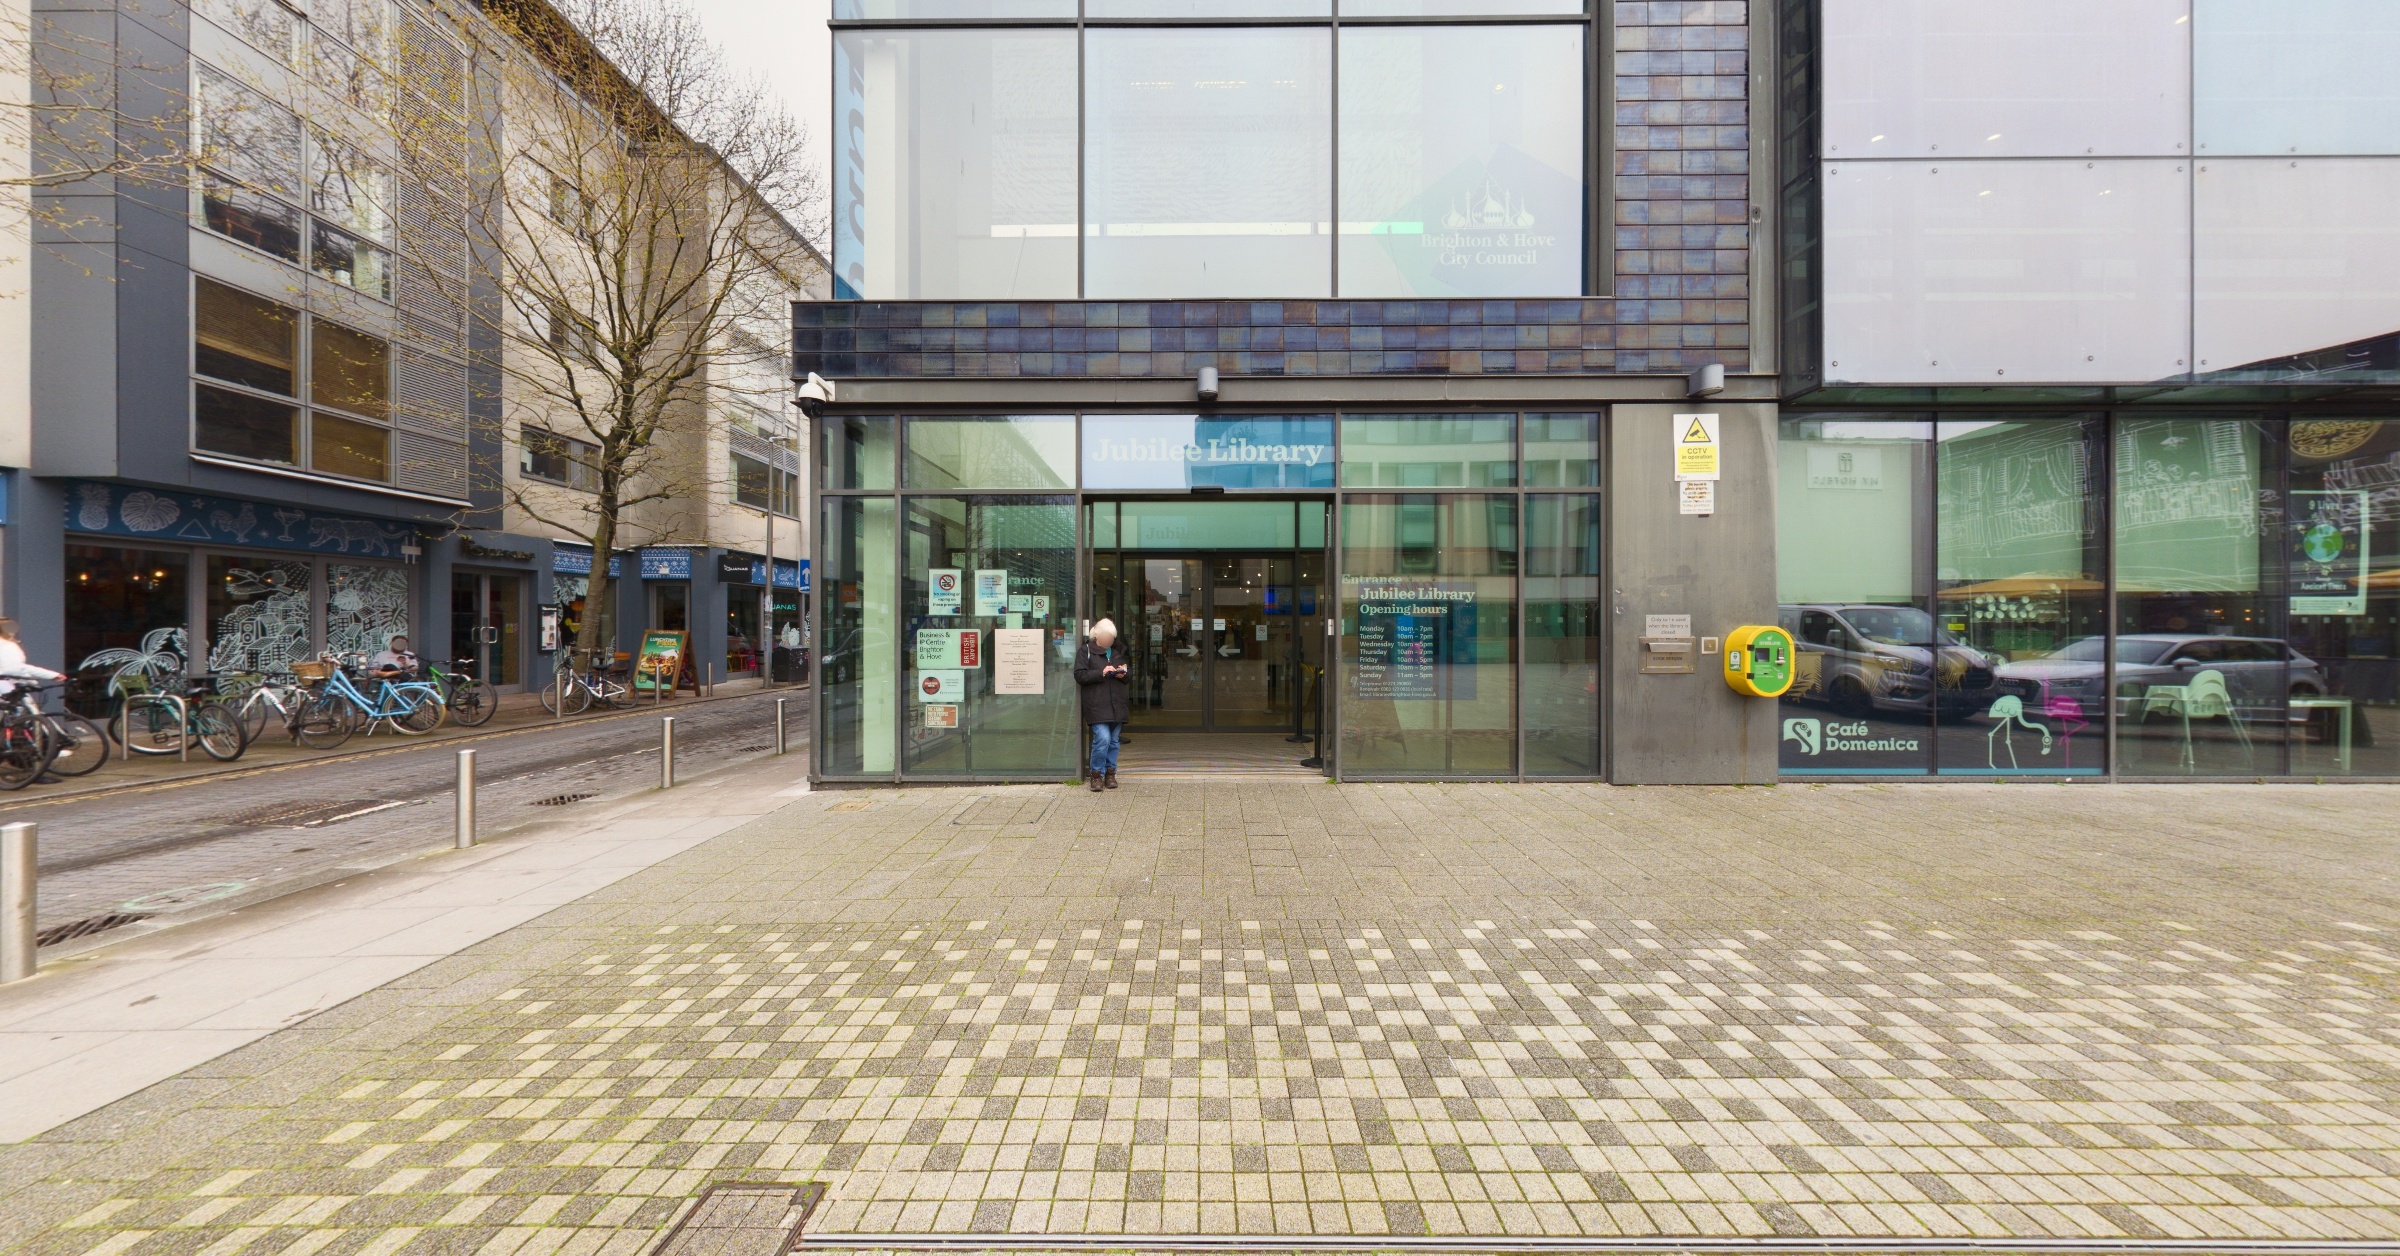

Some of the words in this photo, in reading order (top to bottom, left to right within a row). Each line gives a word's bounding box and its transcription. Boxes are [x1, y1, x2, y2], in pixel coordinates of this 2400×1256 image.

[1421, 233, 1491, 251] Brighton
[1497, 234, 1509, 246] &
[1513, 234, 1555, 246] Hove
[1440, 251, 1471, 268] City
[1476, 250, 1537, 265] Council
[1092, 437, 1202, 462] Jubilee
[1208, 437, 1324, 466] Library
[1008, 577, 1044, 585] rance
[1342, 574, 1402, 584] Entrance
[1361, 588, 1415, 600] Jubilee
[1418, 588, 1475, 603] Library
[1360, 604, 1411, 615] Opening
[1413, 604, 1448, 614] hours
[920, 646, 943, 654] Brighton
[1826, 721, 1868, 736] Café
[1826, 738, 1918, 751] Domenica
